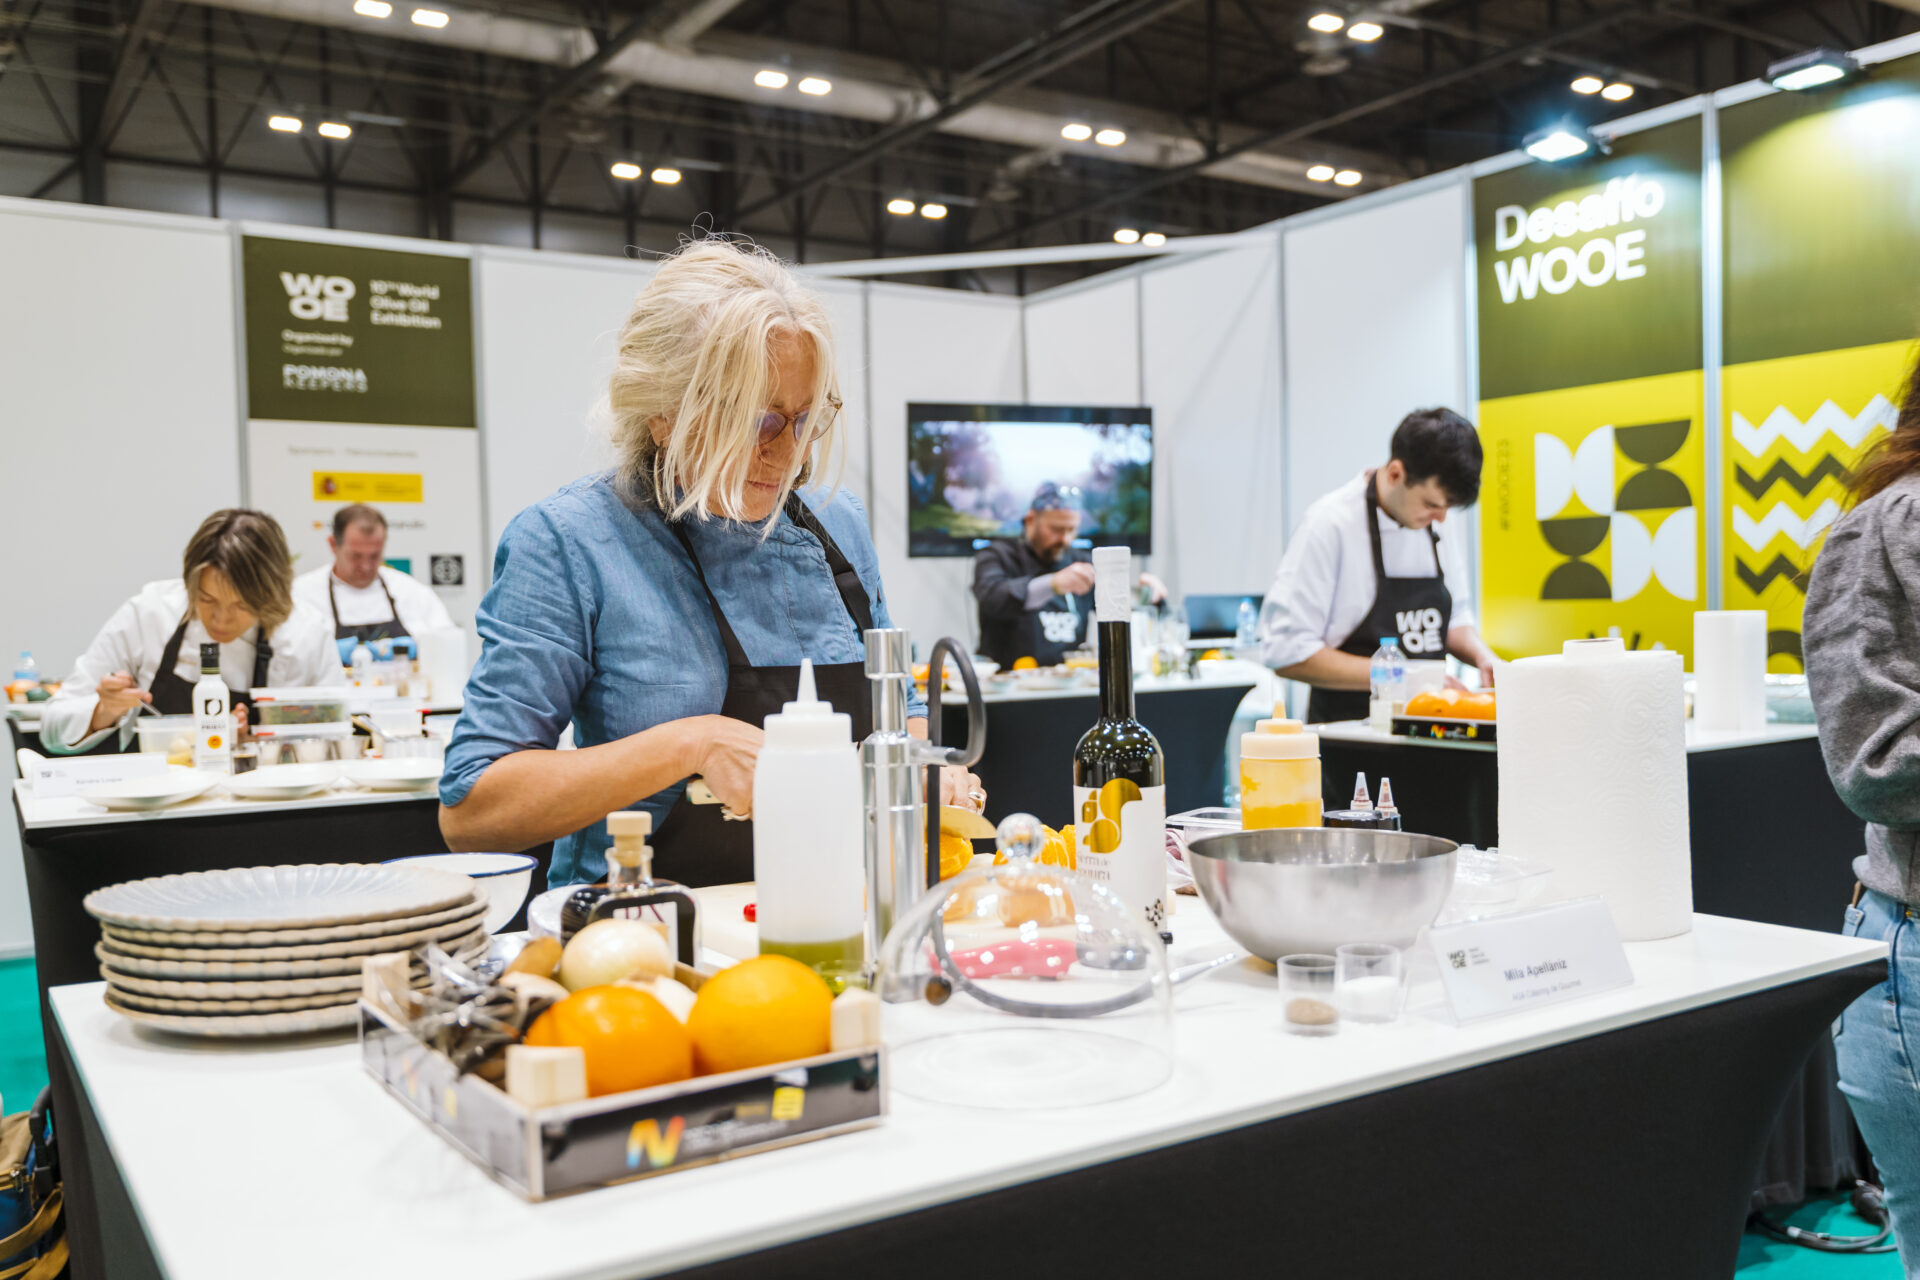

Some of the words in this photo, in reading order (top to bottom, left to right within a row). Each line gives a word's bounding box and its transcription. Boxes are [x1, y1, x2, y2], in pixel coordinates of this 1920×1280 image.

[1494, 229, 1646, 304] WOOE
[280, 271, 356, 299] WO
[289, 297, 349, 322] OE
[283, 364, 367, 382] POMONA
[1396, 607, 1442, 634] WO
[1402, 629, 1443, 653] OE
